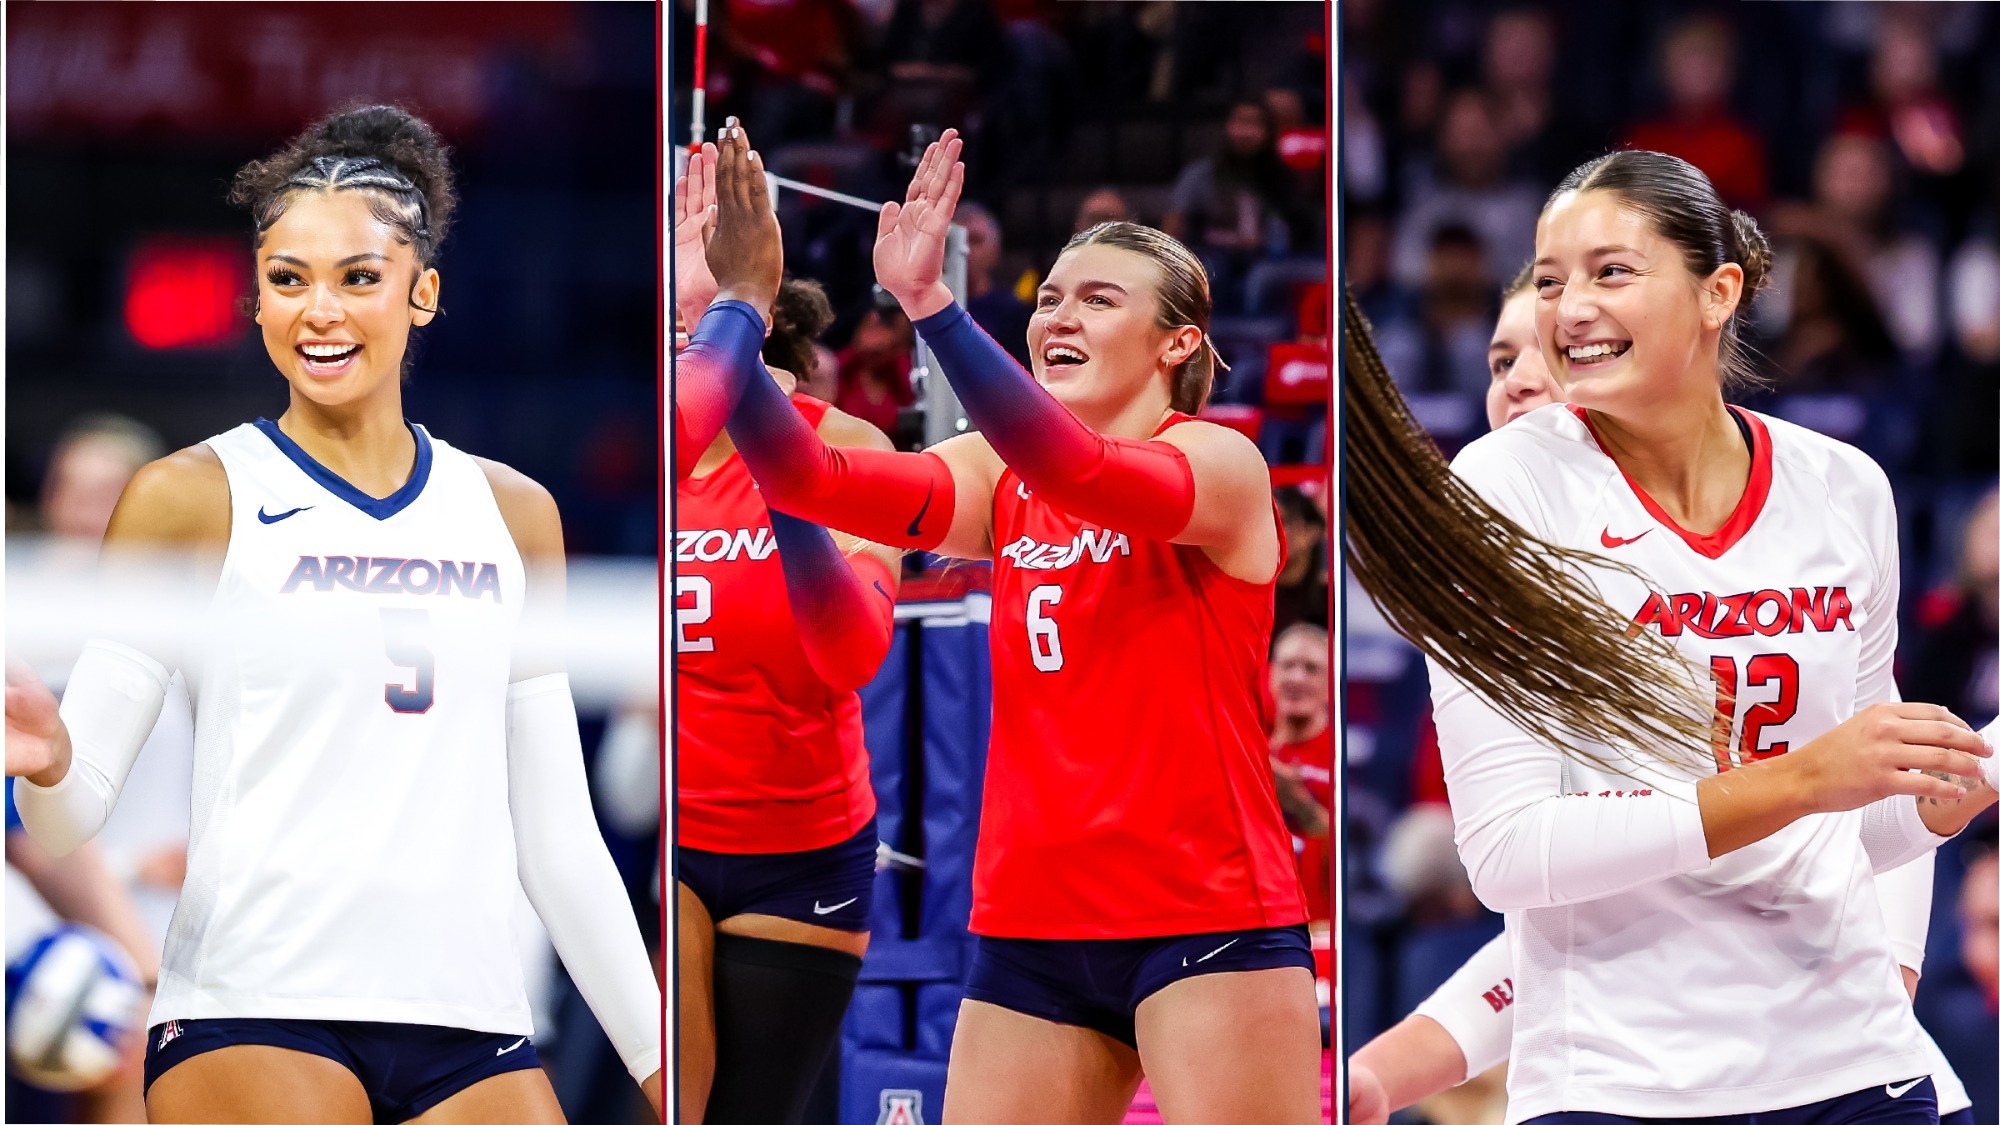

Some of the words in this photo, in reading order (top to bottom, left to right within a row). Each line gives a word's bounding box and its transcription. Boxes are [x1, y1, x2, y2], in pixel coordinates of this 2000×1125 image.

[279, 555, 503, 604] ARIZONA
[1624, 587, 1855, 639] ARIZONA
[377, 606, 435, 715] 5
[1026, 583, 1064, 673] 6
[1710, 652, 1799, 774] 12
